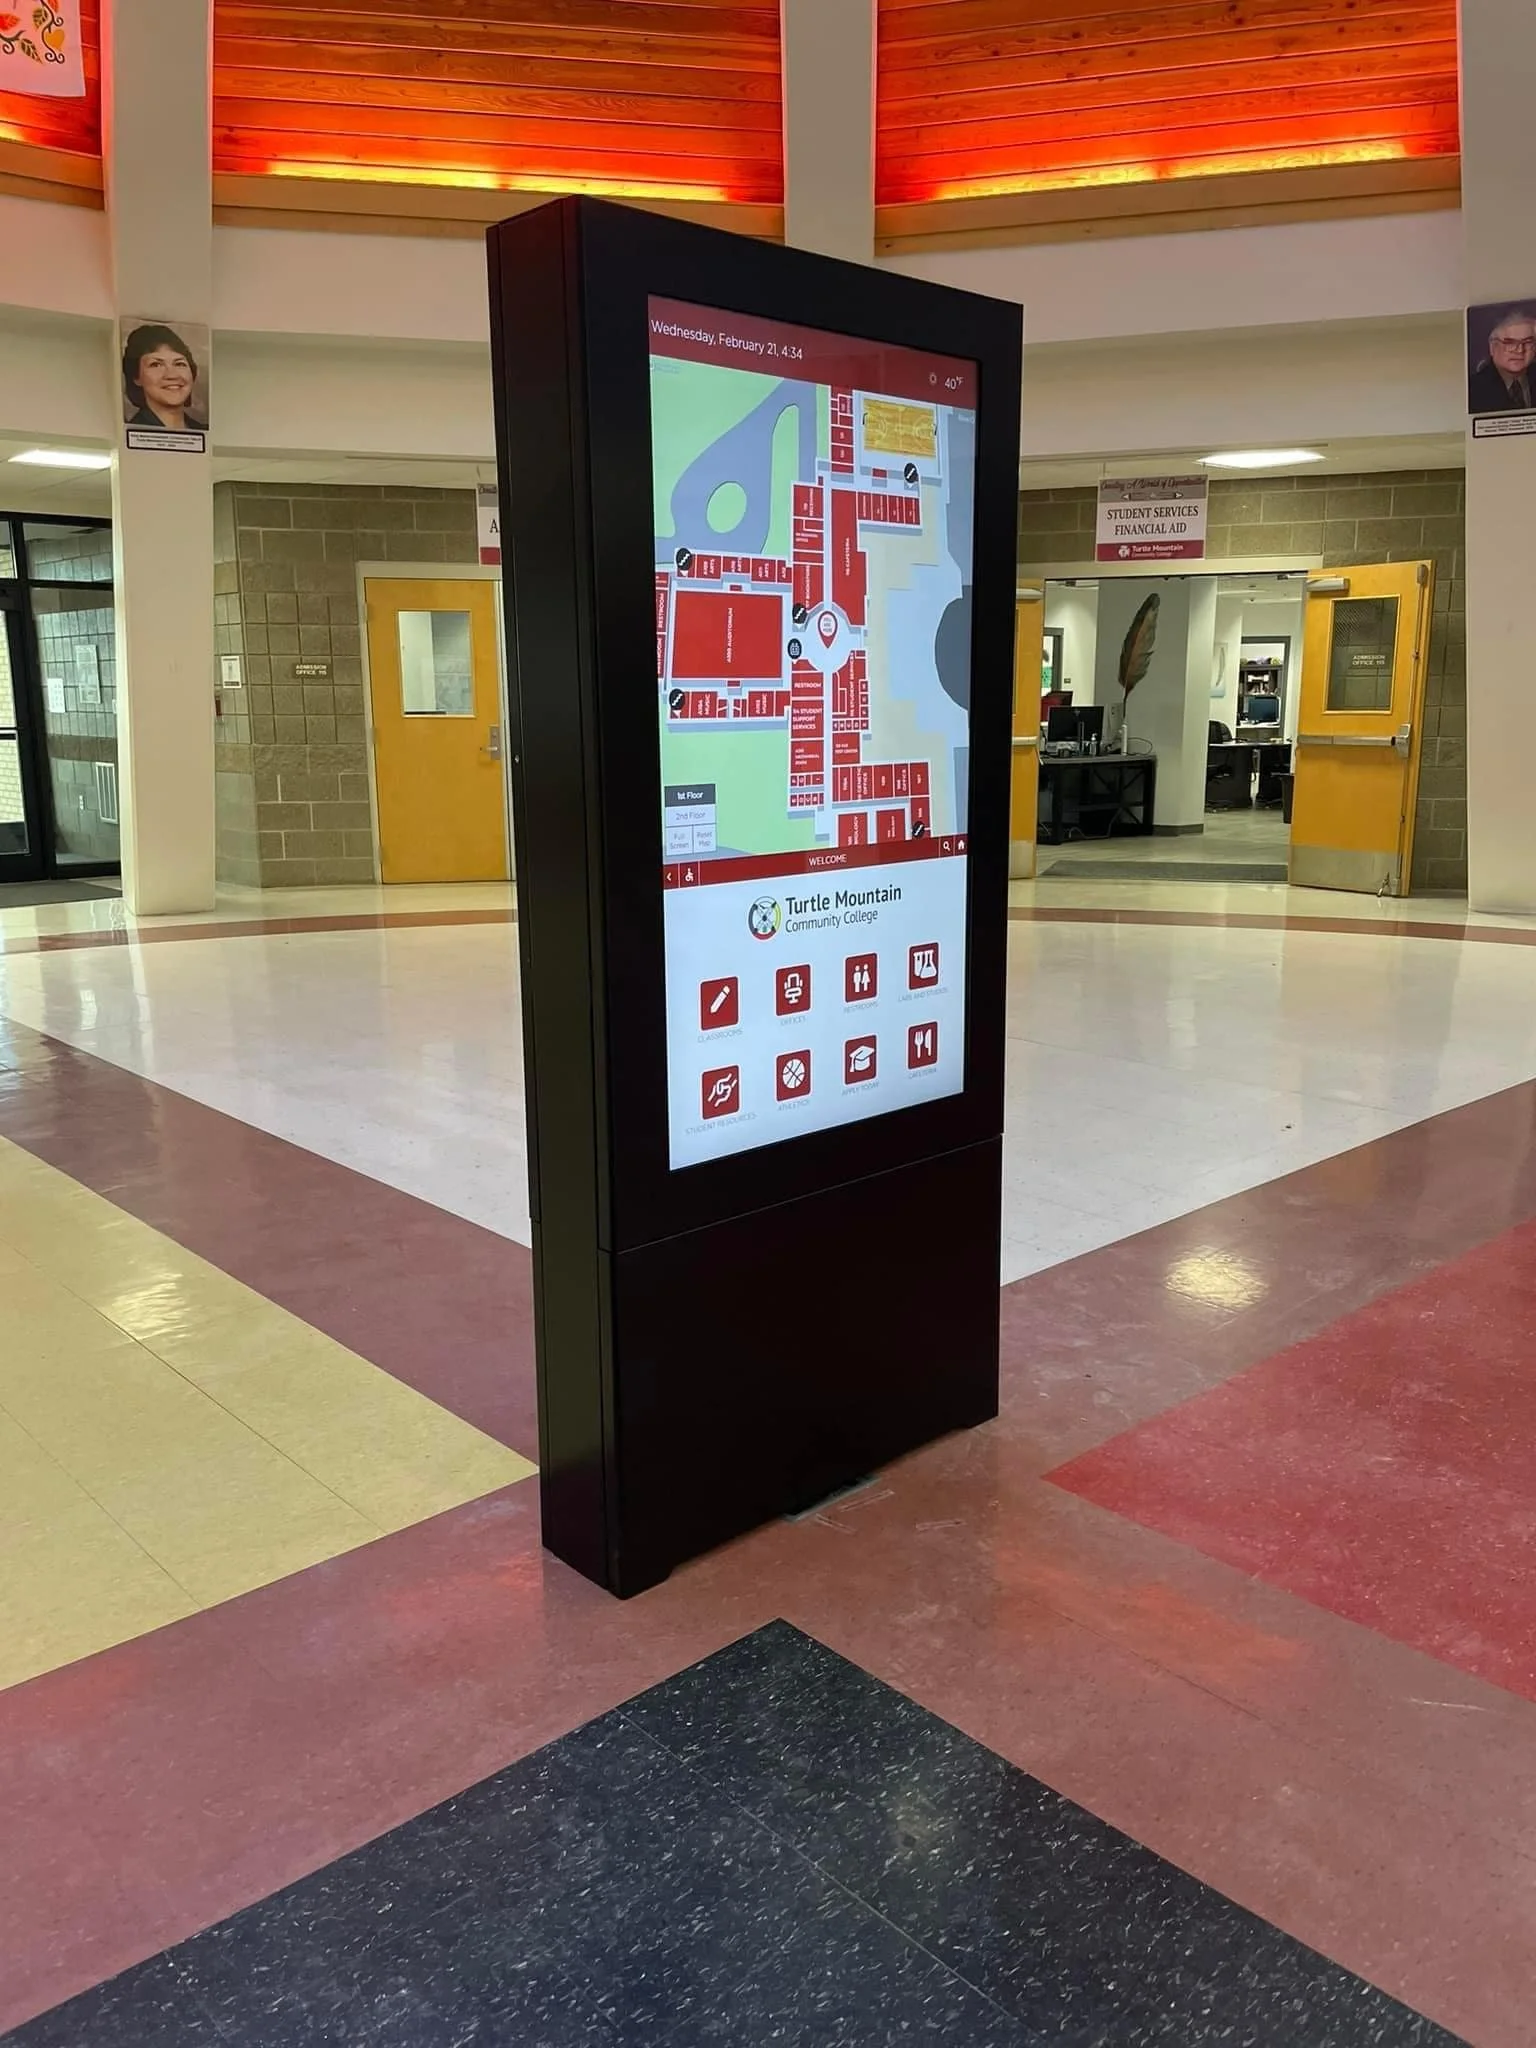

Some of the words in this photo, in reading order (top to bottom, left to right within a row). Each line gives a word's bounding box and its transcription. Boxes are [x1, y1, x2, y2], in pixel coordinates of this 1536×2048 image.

[651, 319, 716, 346] Wednesday,
[719, 332, 764, 355] February
[767, 342, 779, 358] 21,
[782, 345, 803, 360] 4:34
[1107, 507, 1152, 520] STUDENT
[1153, 505, 1199, 518] SERVICES
[1114, 523, 1168, 536] FINANCIAL
[1169, 522, 1187, 534] AID
[1131, 545, 1152, 553] Turtle
[1152, 543, 1184, 552] Mountain
[677, 791, 686, 800] 1st
[686, 791, 704, 800] Floor
[675, 812, 688, 821] 2nd
[689, 810, 706, 819] Floor
[808, 854, 847, 866] WELCOME
[785, 893, 830, 915] Turtle
[835, 884, 902, 909] Mountain
[785, 914, 841, 934] Community
[843, 910, 878, 925] College
